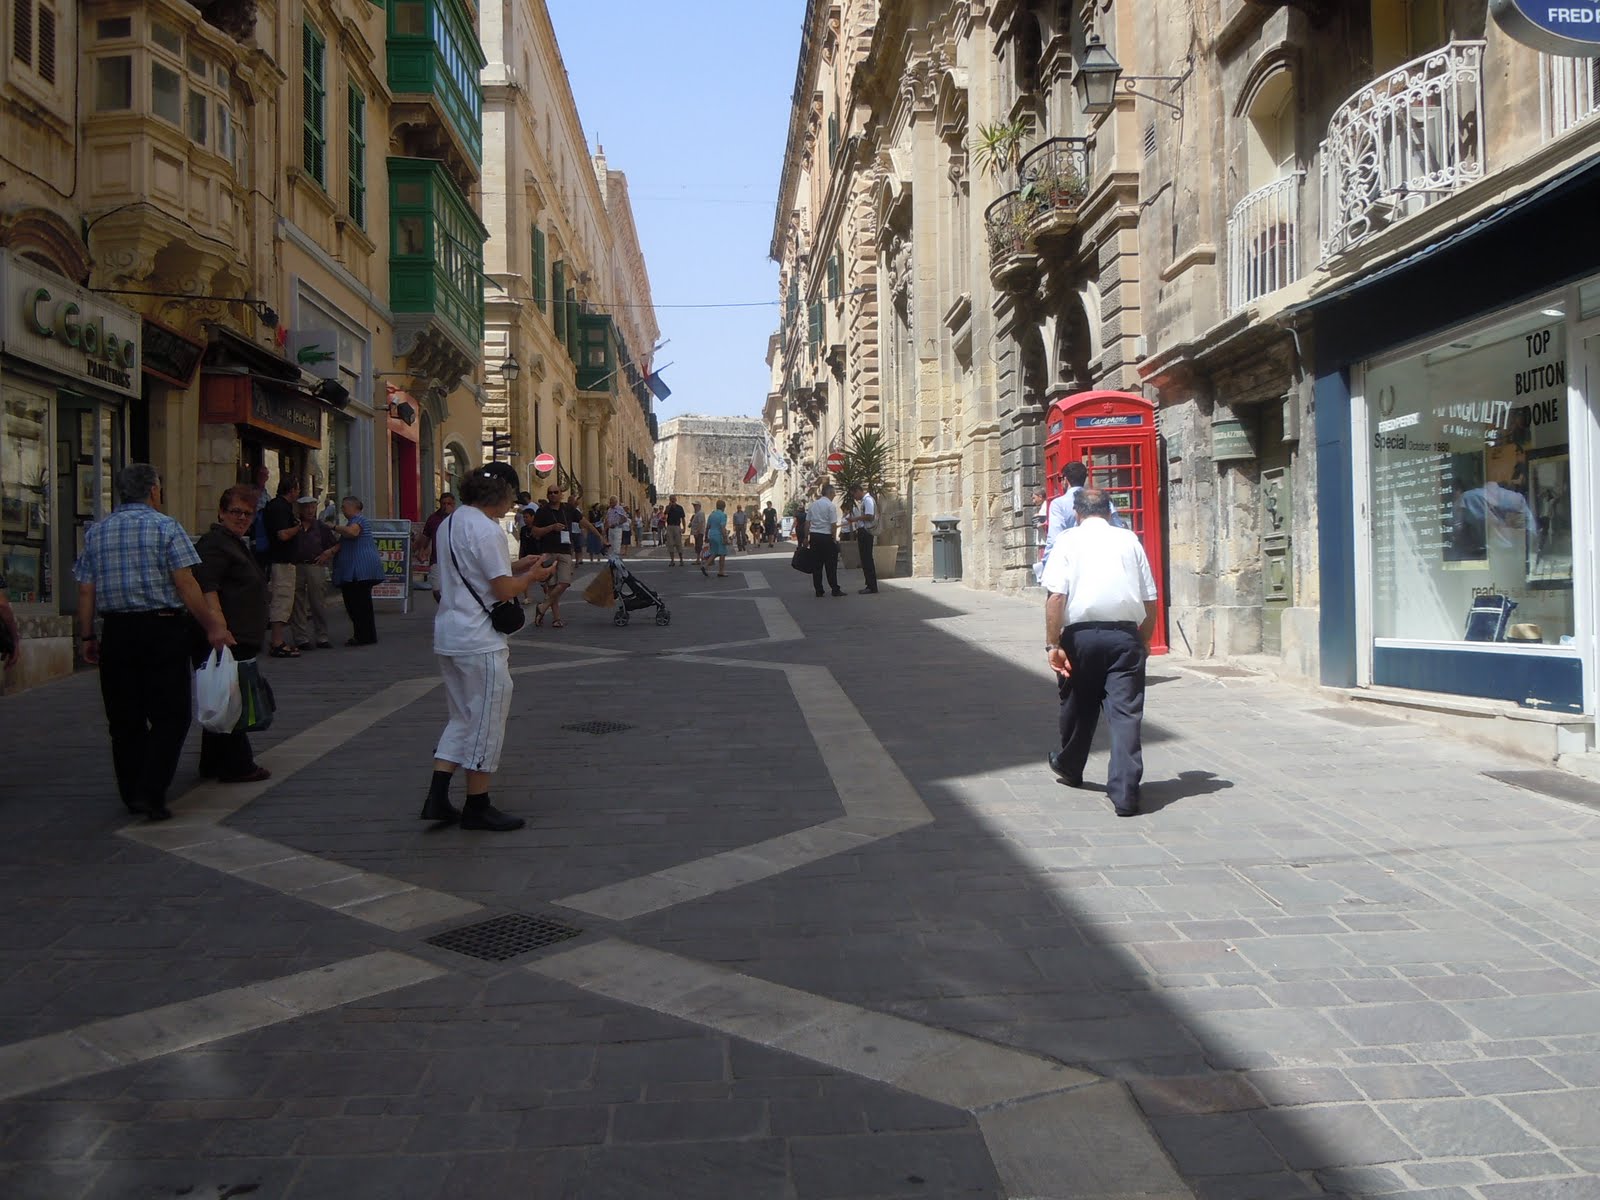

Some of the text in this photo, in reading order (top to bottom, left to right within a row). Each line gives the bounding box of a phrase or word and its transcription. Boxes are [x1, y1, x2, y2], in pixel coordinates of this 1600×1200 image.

[1547, 7, 1594, 23] FRED
[55, 302, 135, 369] Galea
[1525, 329, 1551, 358] TOP
[1515, 360, 1565, 396] BUTTON
[1526, 398, 1559, 427] DONE
[1374, 432, 1407, 452] Special
[1471, 582, 1496, 599] read
